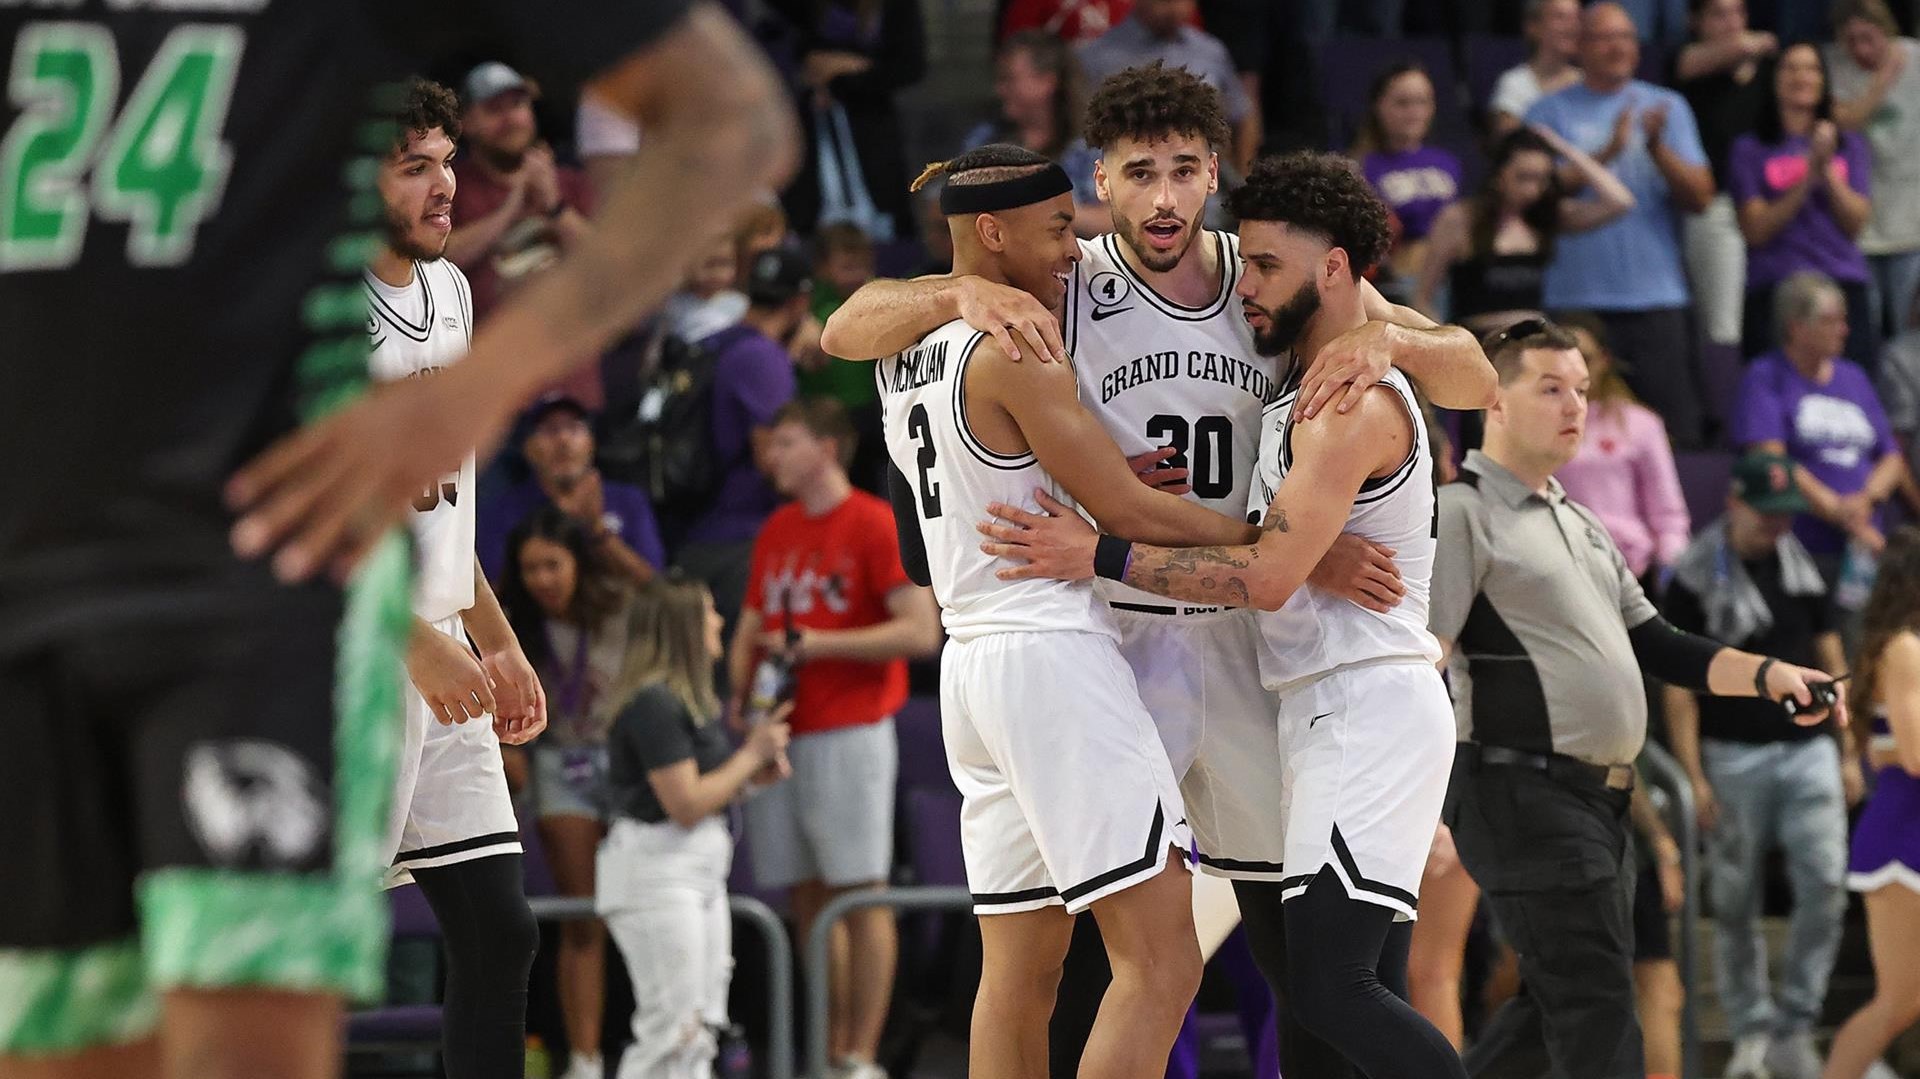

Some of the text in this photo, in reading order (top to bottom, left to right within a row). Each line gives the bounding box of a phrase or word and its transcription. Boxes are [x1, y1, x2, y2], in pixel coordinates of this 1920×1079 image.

[0, 20, 247, 272] 24
[1102, 278, 1116, 299] 4
[1102, 351, 1274, 405] GRAND CANYON
[908, 403, 943, 519] 2
[1146, 414, 1233, 499] 30
